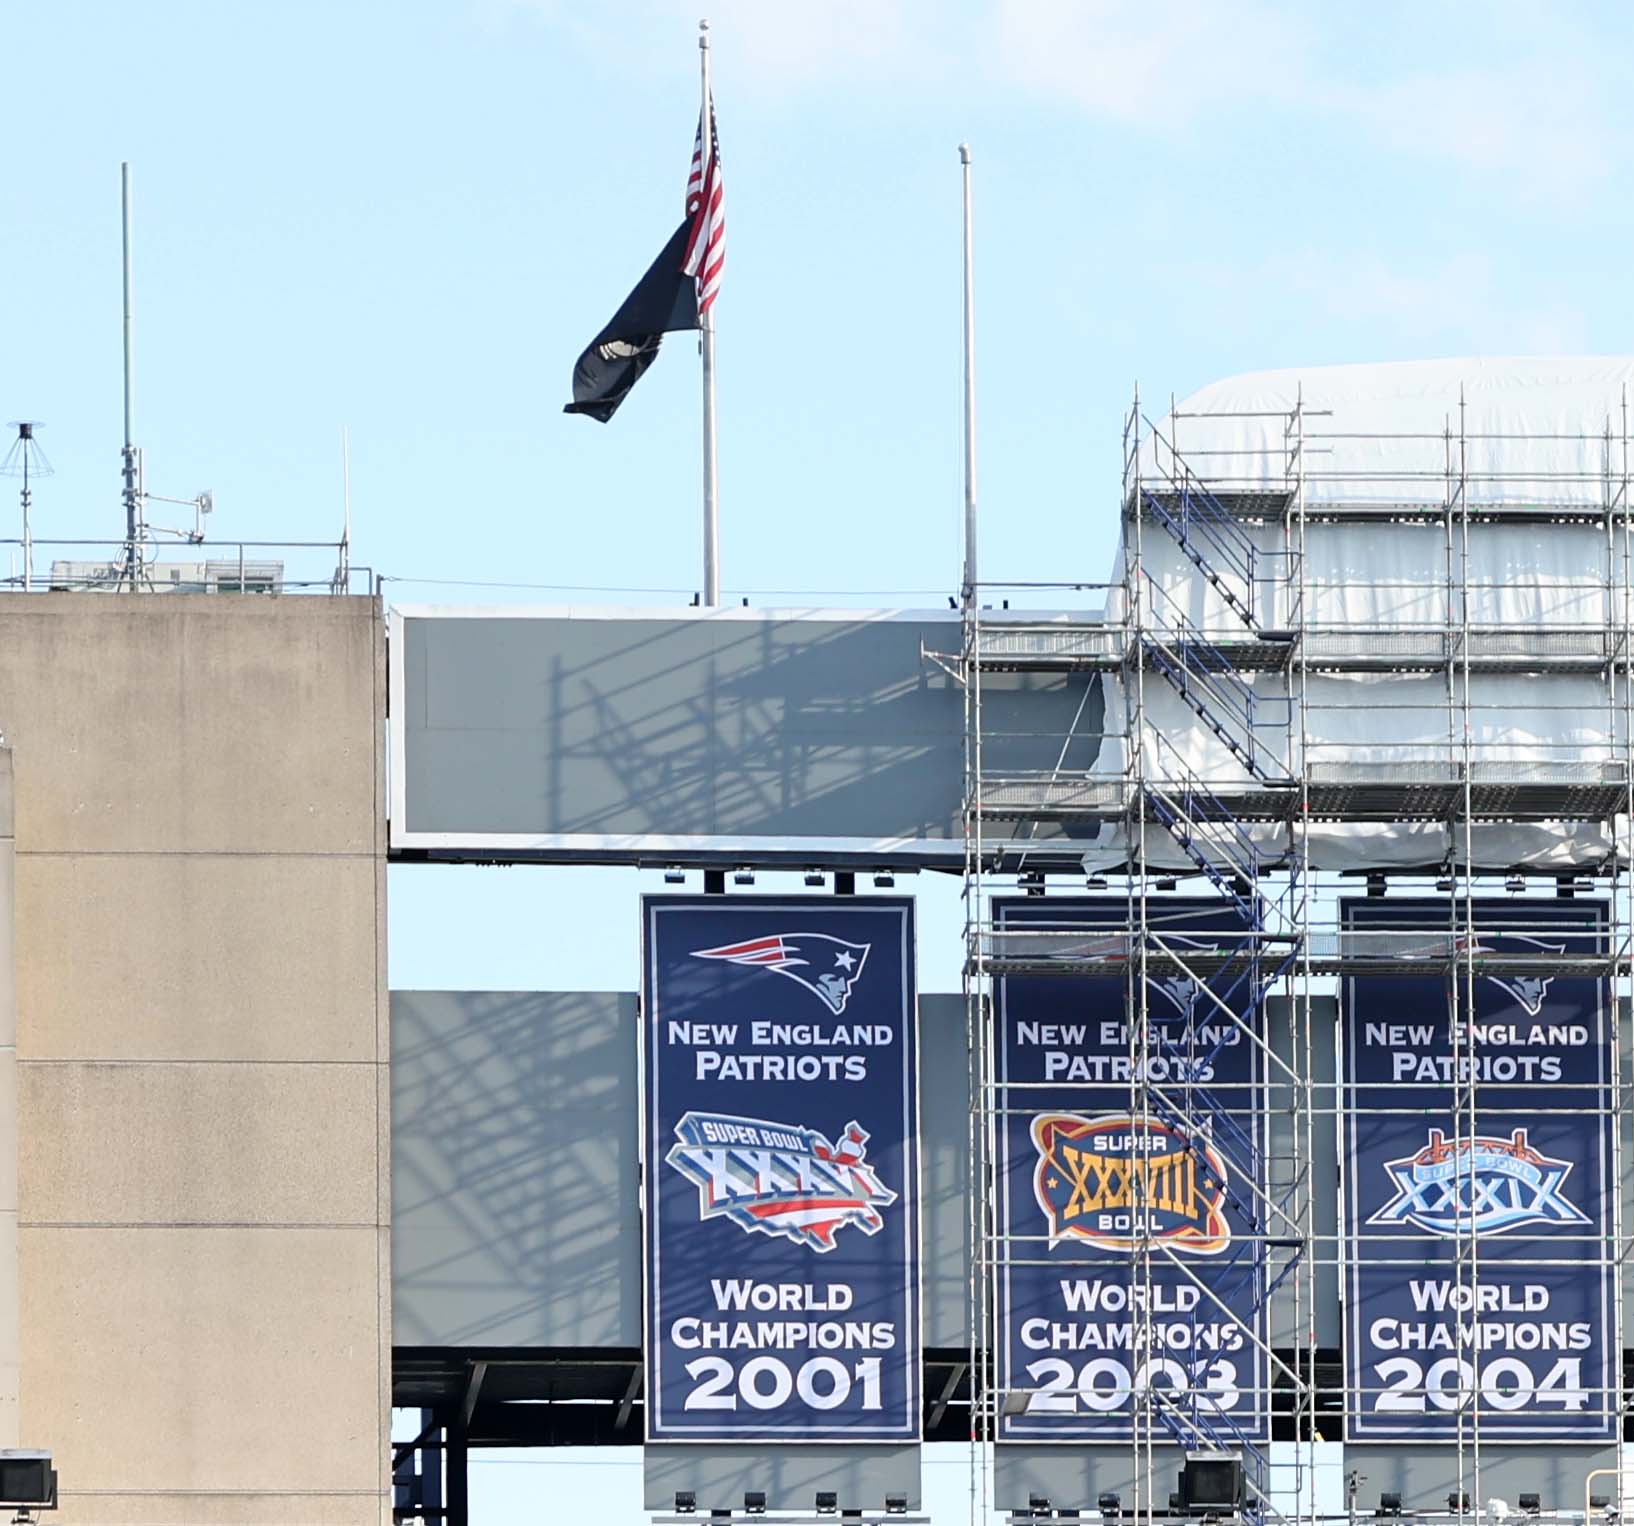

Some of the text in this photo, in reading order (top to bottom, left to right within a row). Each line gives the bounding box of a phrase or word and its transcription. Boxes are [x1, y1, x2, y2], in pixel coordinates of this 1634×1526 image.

[668, 1021, 893, 1045] NEW ENGLAND
[1017, 1021, 1086, 1045] NEW
[1365, 1022, 1589, 1046] NEW ENGLAND
[696, 1051, 867, 1081] PATRIOTS
[1392, 1052, 1562, 1081] PATRIOTS
[702, 1121, 809, 1152] SUPER BOWL
[1094, 1136, 1167, 1151] SUPER
[1486, 1158, 1530, 1178] BOWL
[1381, 1171, 1577, 1219] XXXIX
[711, 1279, 853, 1311] WORLD
[1060, 1280, 1201, 1312] WORLD
[1409, 1280, 1549, 1312] WORLD
[671, 1317, 896, 1349] CHAMPIONS
[1370, 1318, 1591, 1350] CHAMPIONS
[684, 1356, 883, 1411] 2001
[1026, 1357, 1240, 1412] 2003
[1374, 1357, 1589, 1412] 2004
